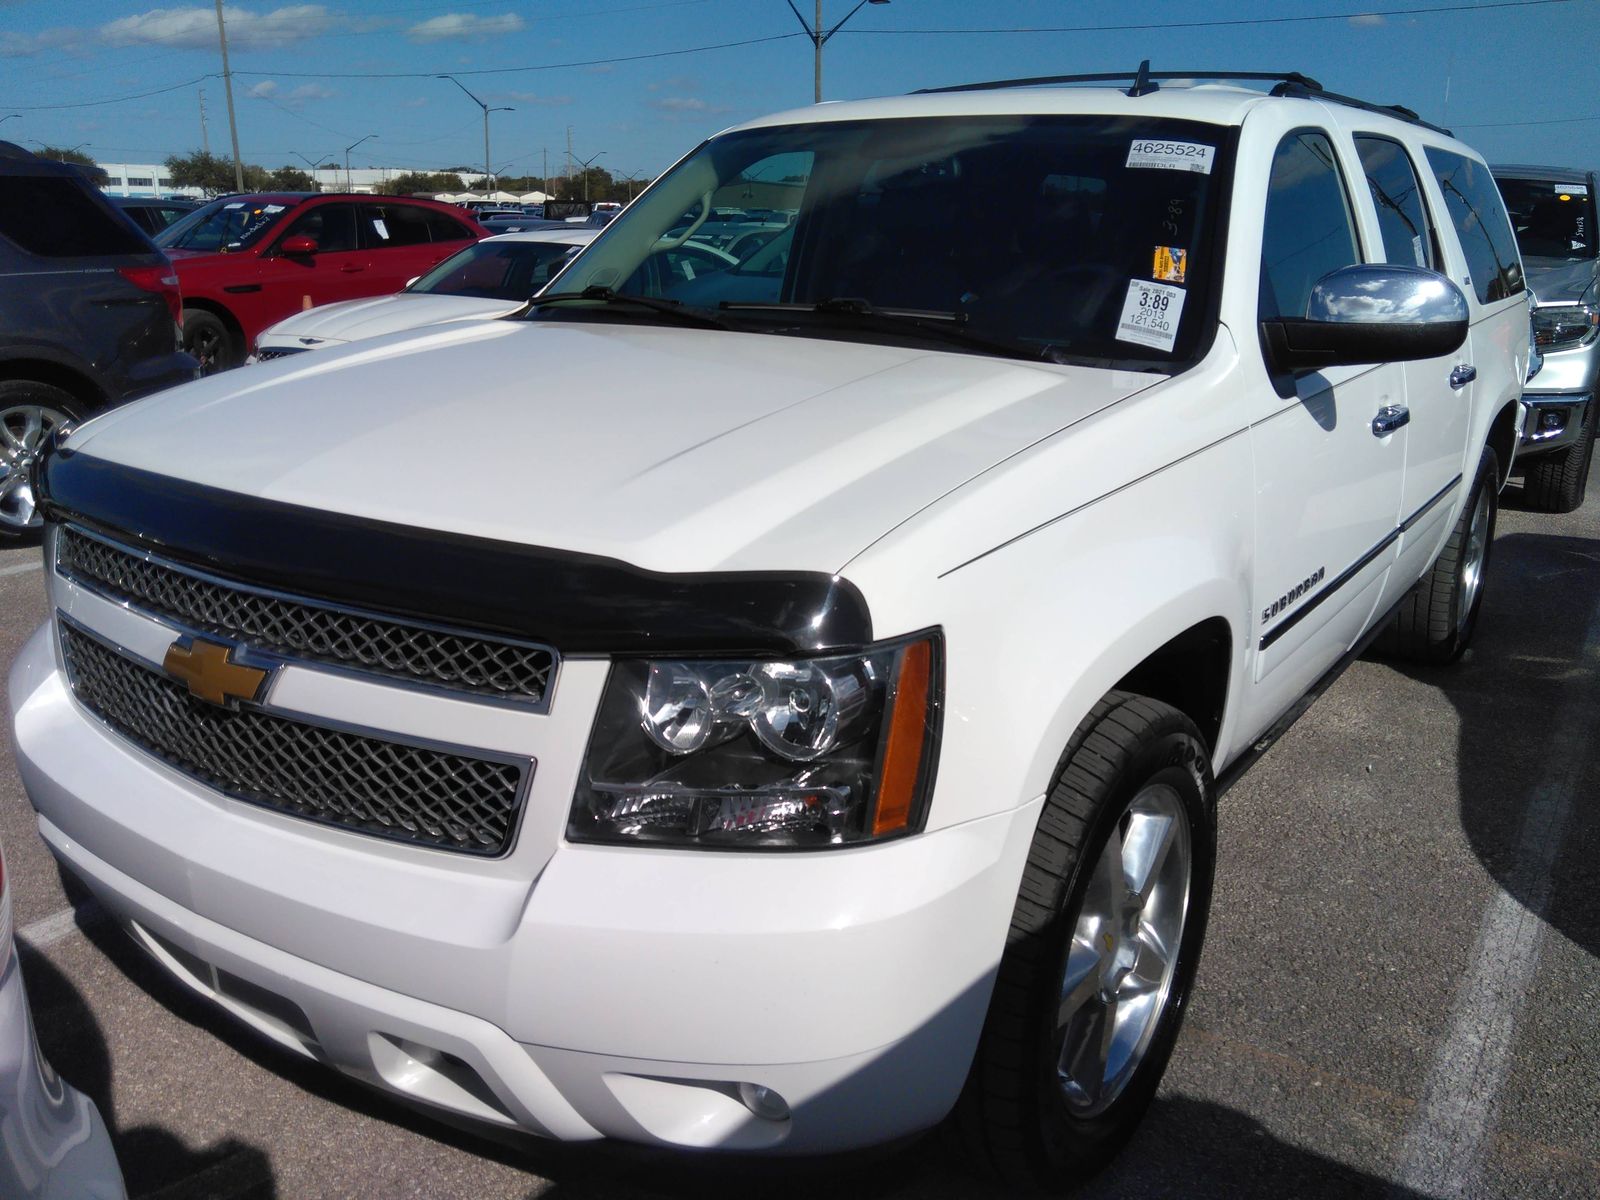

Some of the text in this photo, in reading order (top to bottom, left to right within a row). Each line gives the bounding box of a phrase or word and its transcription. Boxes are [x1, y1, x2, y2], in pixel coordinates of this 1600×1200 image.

[1133, 143, 1206, 158] 4625524
[1139, 292, 1169, 311] 3:89
[1140, 307, 1165, 320] 2013
[1130, 314, 1170, 331] 121,540
[1261, 566, 1325, 625] SUBURBAN
